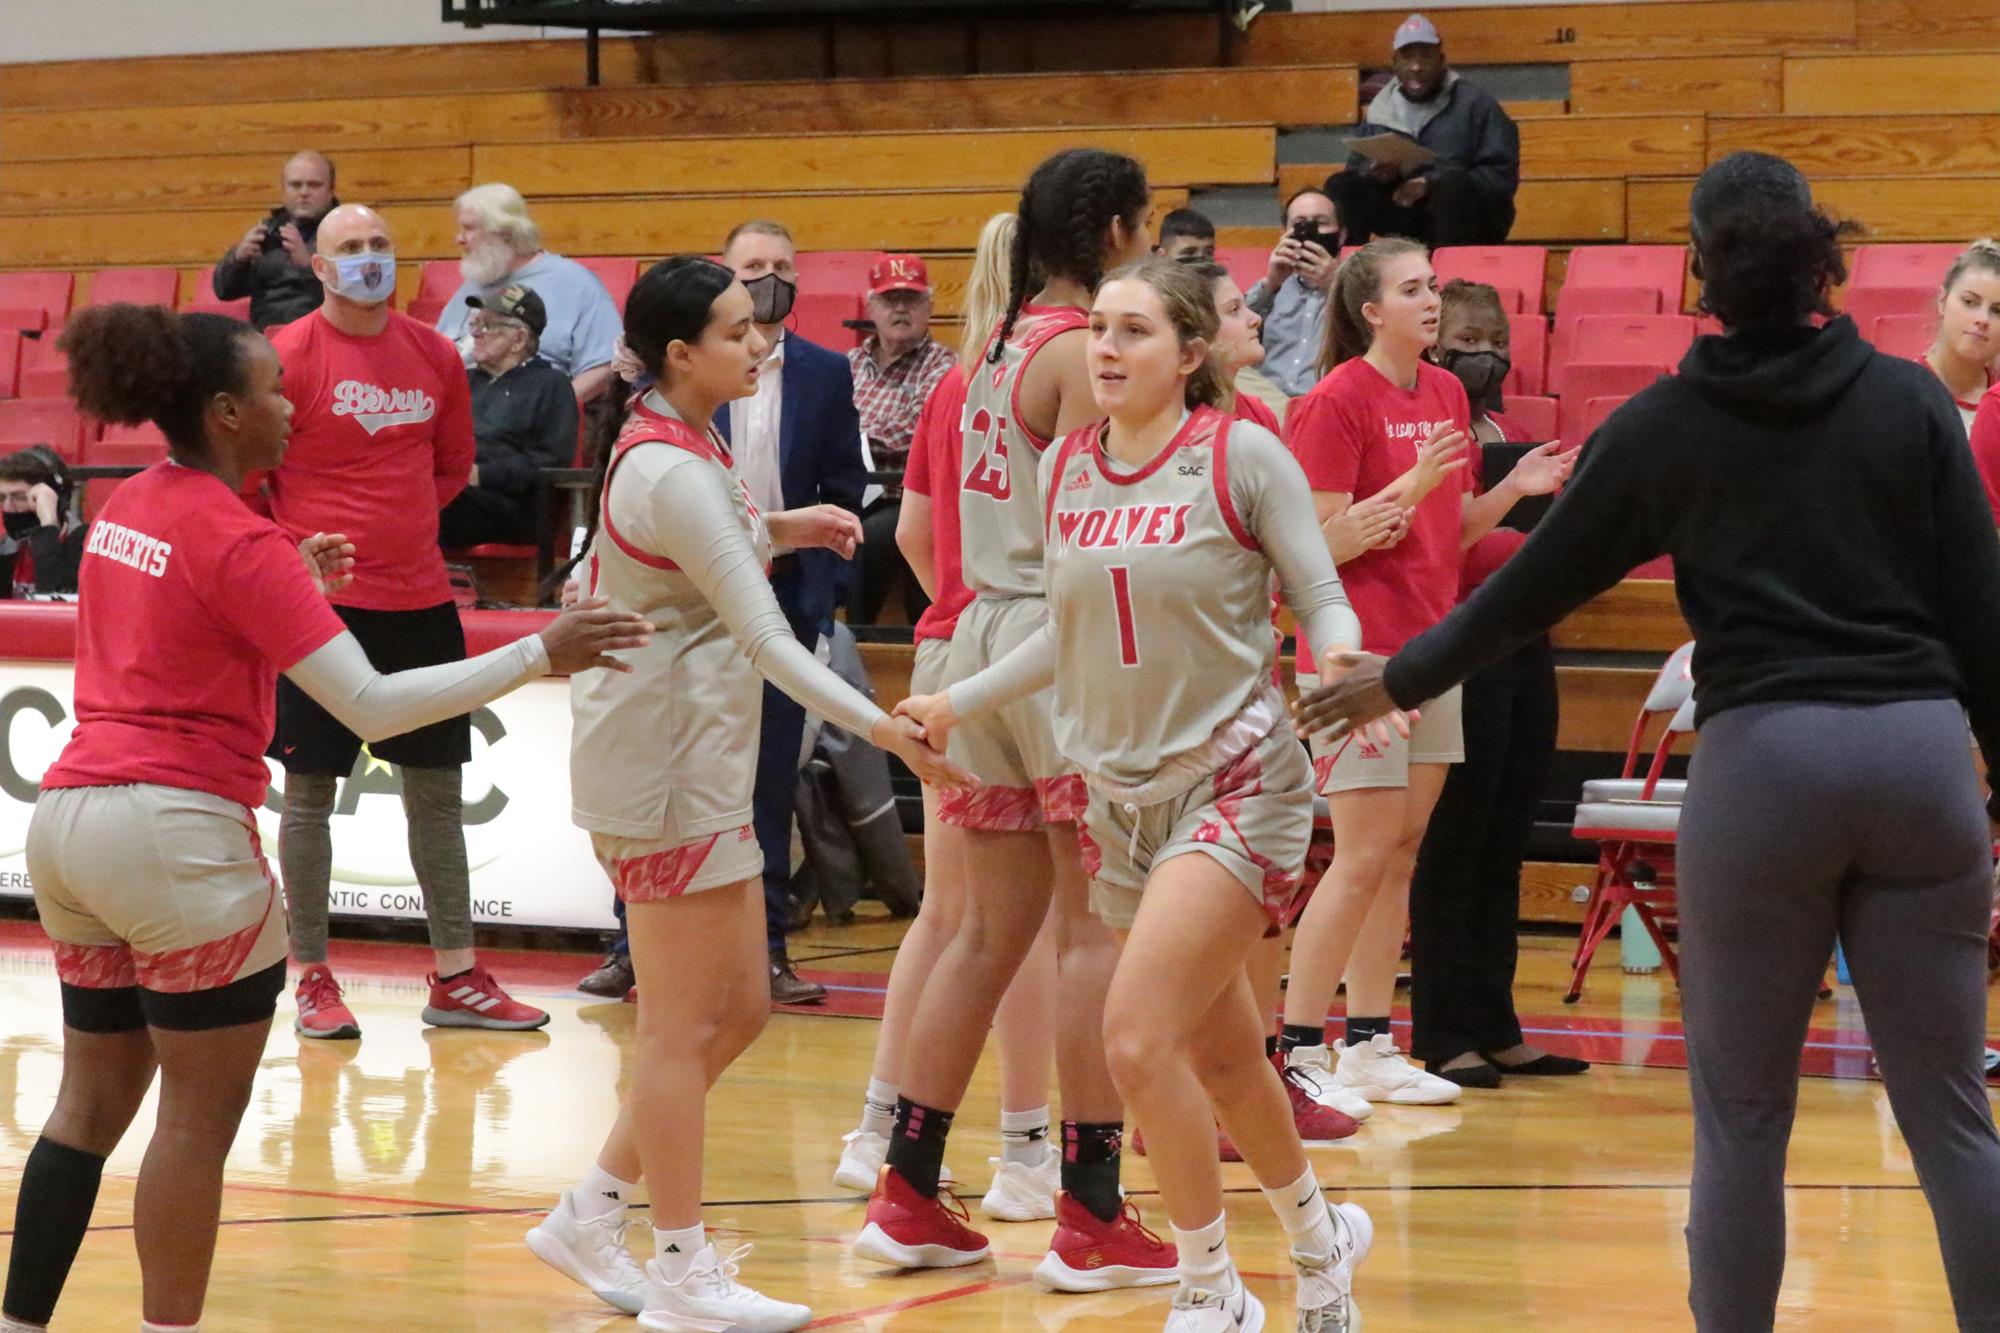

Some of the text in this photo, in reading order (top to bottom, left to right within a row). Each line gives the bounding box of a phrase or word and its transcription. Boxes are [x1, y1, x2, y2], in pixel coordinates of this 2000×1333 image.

[332, 380, 436, 436] Berry
[961, 406, 1012, 502] 25
[1177, 466, 1204, 476] SAC
[87, 520, 172, 578] ROBERTS
[1056, 503, 1194, 556] WOLVES
[1104, 565, 1141, 668] 1
[380, 893, 513, 917] CONNCE
